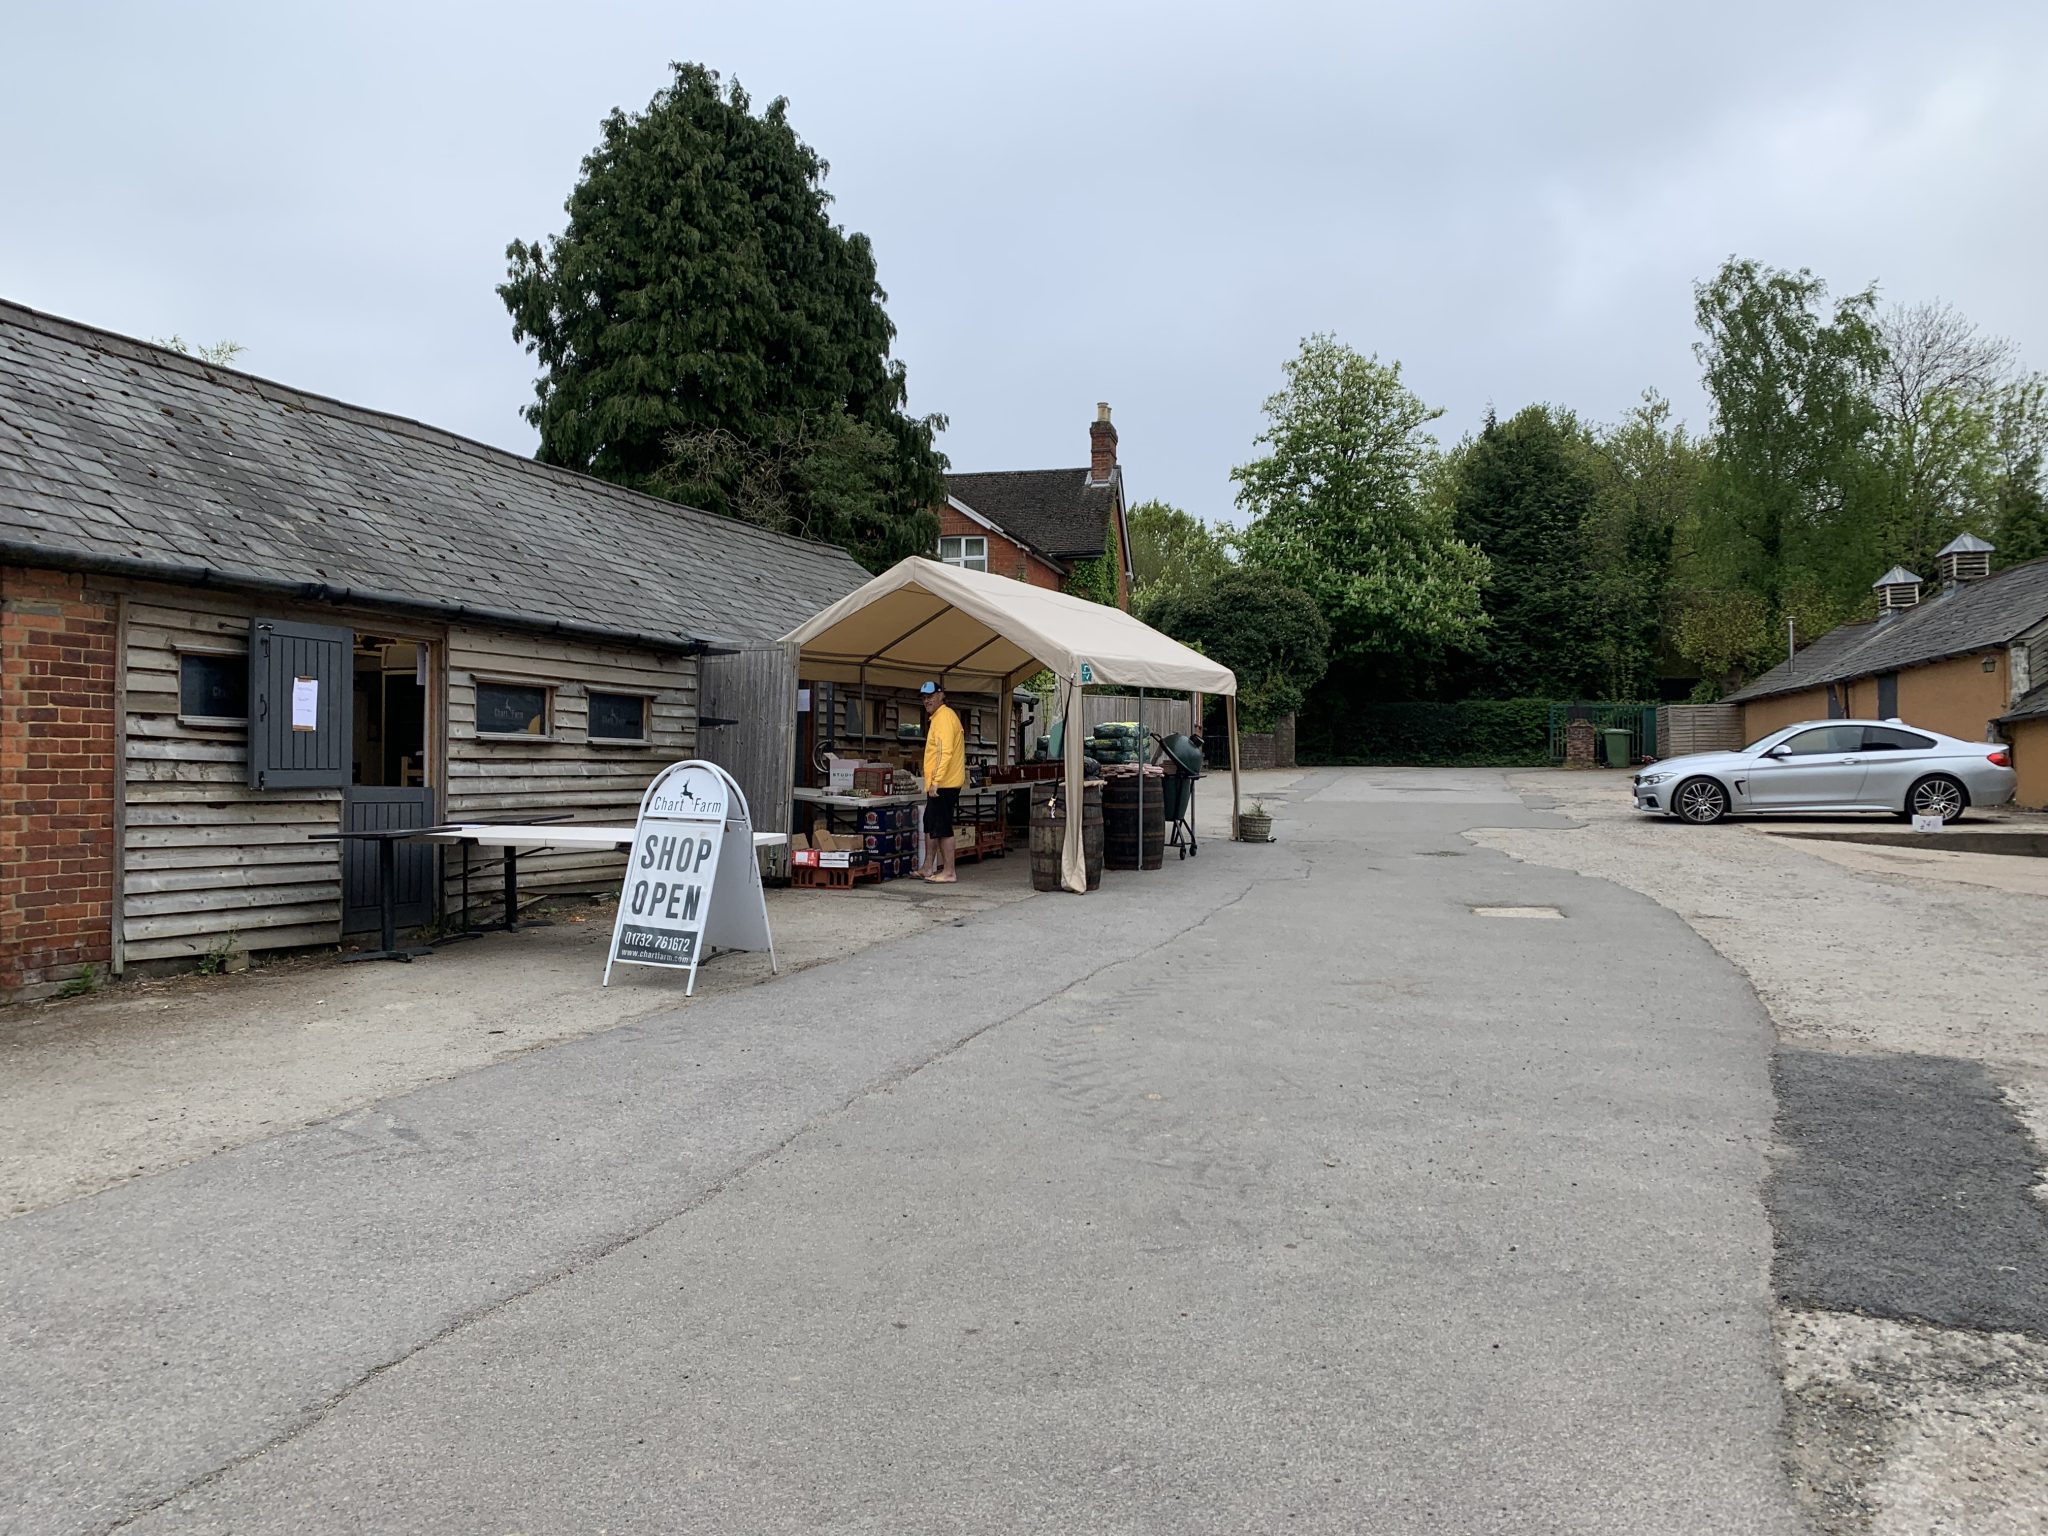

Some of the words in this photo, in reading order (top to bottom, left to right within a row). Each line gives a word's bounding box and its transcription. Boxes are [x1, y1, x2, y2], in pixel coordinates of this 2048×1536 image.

[654, 796, 684, 812] Chart
[693, 798, 722, 813] Farm
[641, 834, 712, 873] SHOP
[631, 880, 701, 921] OPEN
[624, 931, 653, 947] 01732
[654, 935, 690, 952] 761672
[621, 949, 689, 963] www.chartfarm.com
